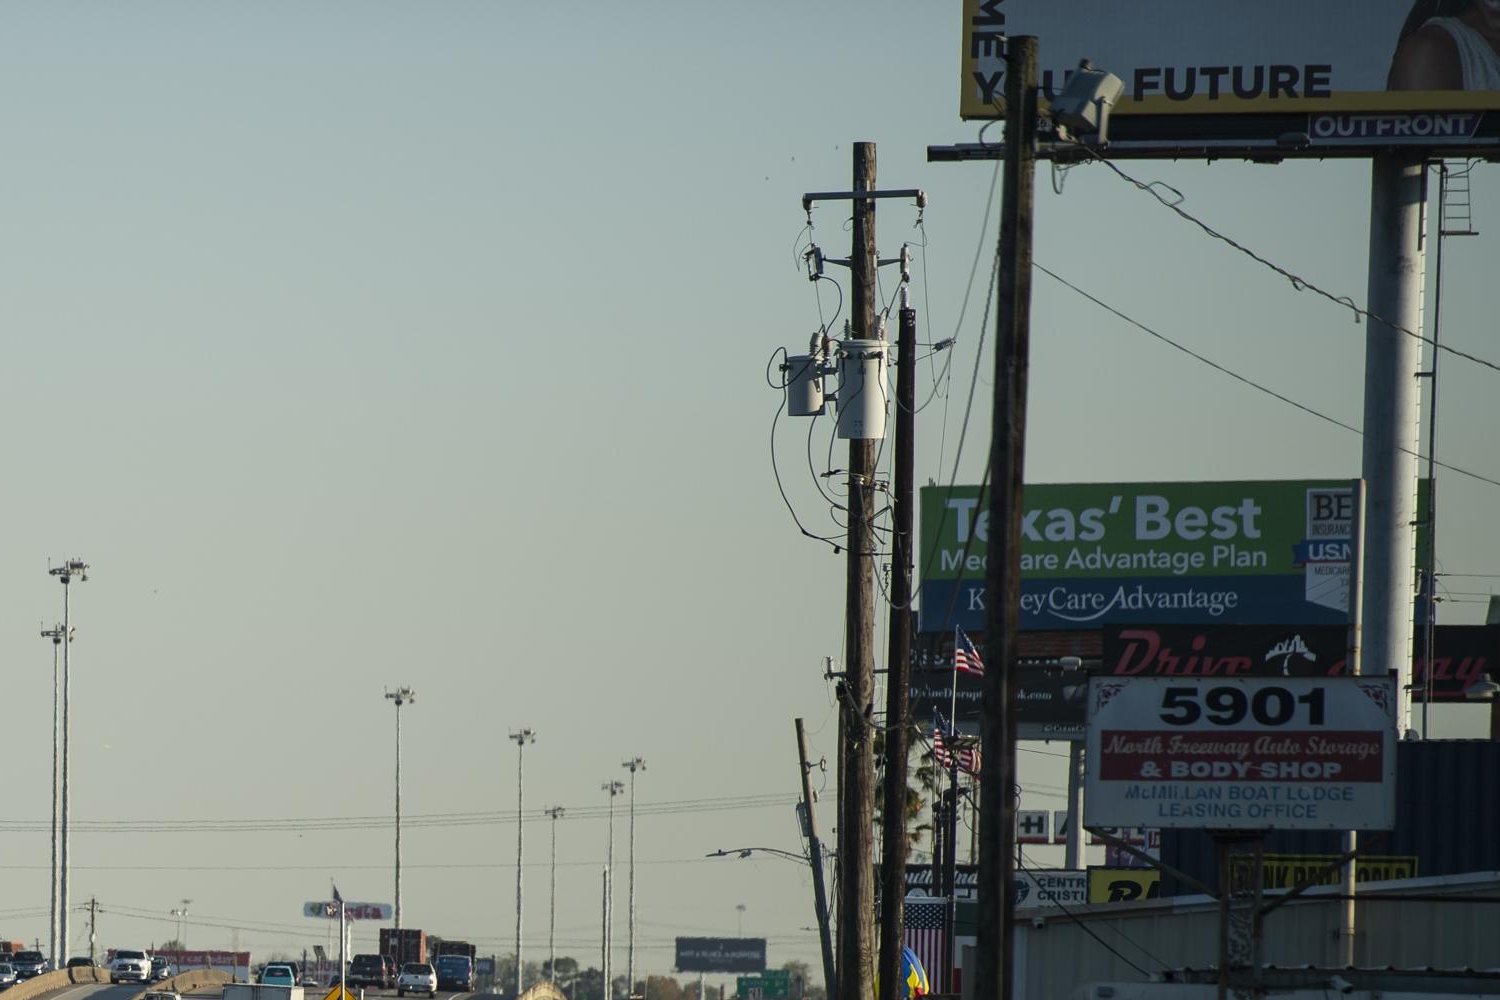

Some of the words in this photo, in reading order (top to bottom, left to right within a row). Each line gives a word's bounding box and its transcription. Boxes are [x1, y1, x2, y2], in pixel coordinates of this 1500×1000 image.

[1133, 64, 1332, 103] FUTURE
[1315, 114, 1474, 138] OUTFRONT
[1135, 495, 1262, 541] Best
[1066, 545, 1206, 575] Advantage
[1212, 544, 1267, 568] Plan
[1118, 584, 1239, 617] Advantage
[1159, 686, 1325, 726] 5901
[1104, 735, 1164, 755] North
[1166, 735, 1250, 761] Freeway
[1254, 736, 1301, 755] Auto
[1305, 736, 1380, 761] Storage
[1140, 761, 1164, 778] &
[1171, 761, 1250, 778] BODY
[1260, 761, 1342, 778] SHOP
[1229, 786, 1281, 801] BOAT
[1287, 786, 1354, 801] LODGE
[1158, 803, 1241, 818] LEASING
[1248, 804, 1317, 818] OFFICE
